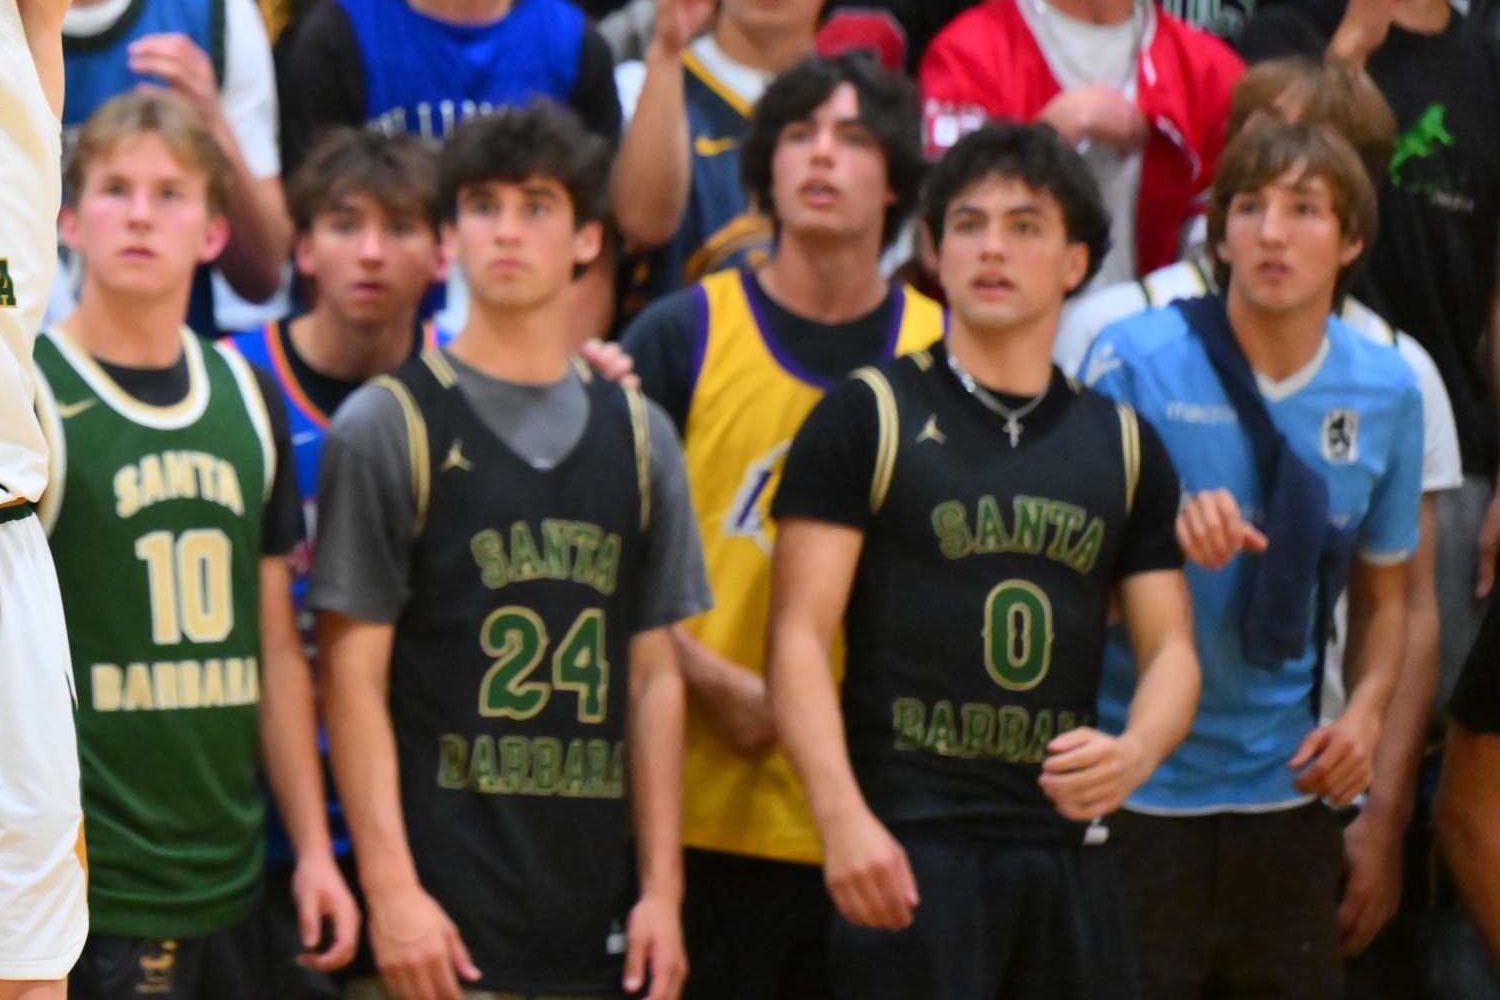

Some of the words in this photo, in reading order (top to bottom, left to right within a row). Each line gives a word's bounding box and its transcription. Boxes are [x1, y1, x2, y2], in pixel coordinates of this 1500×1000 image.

[113, 450, 245, 519] SANTA
[470, 518, 622, 596] SANTA
[931, 494, 1106, 575] SANTA
[135, 528, 235, 645] 10
[981, 578, 1054, 692] 0
[478, 605, 610, 724] 24
